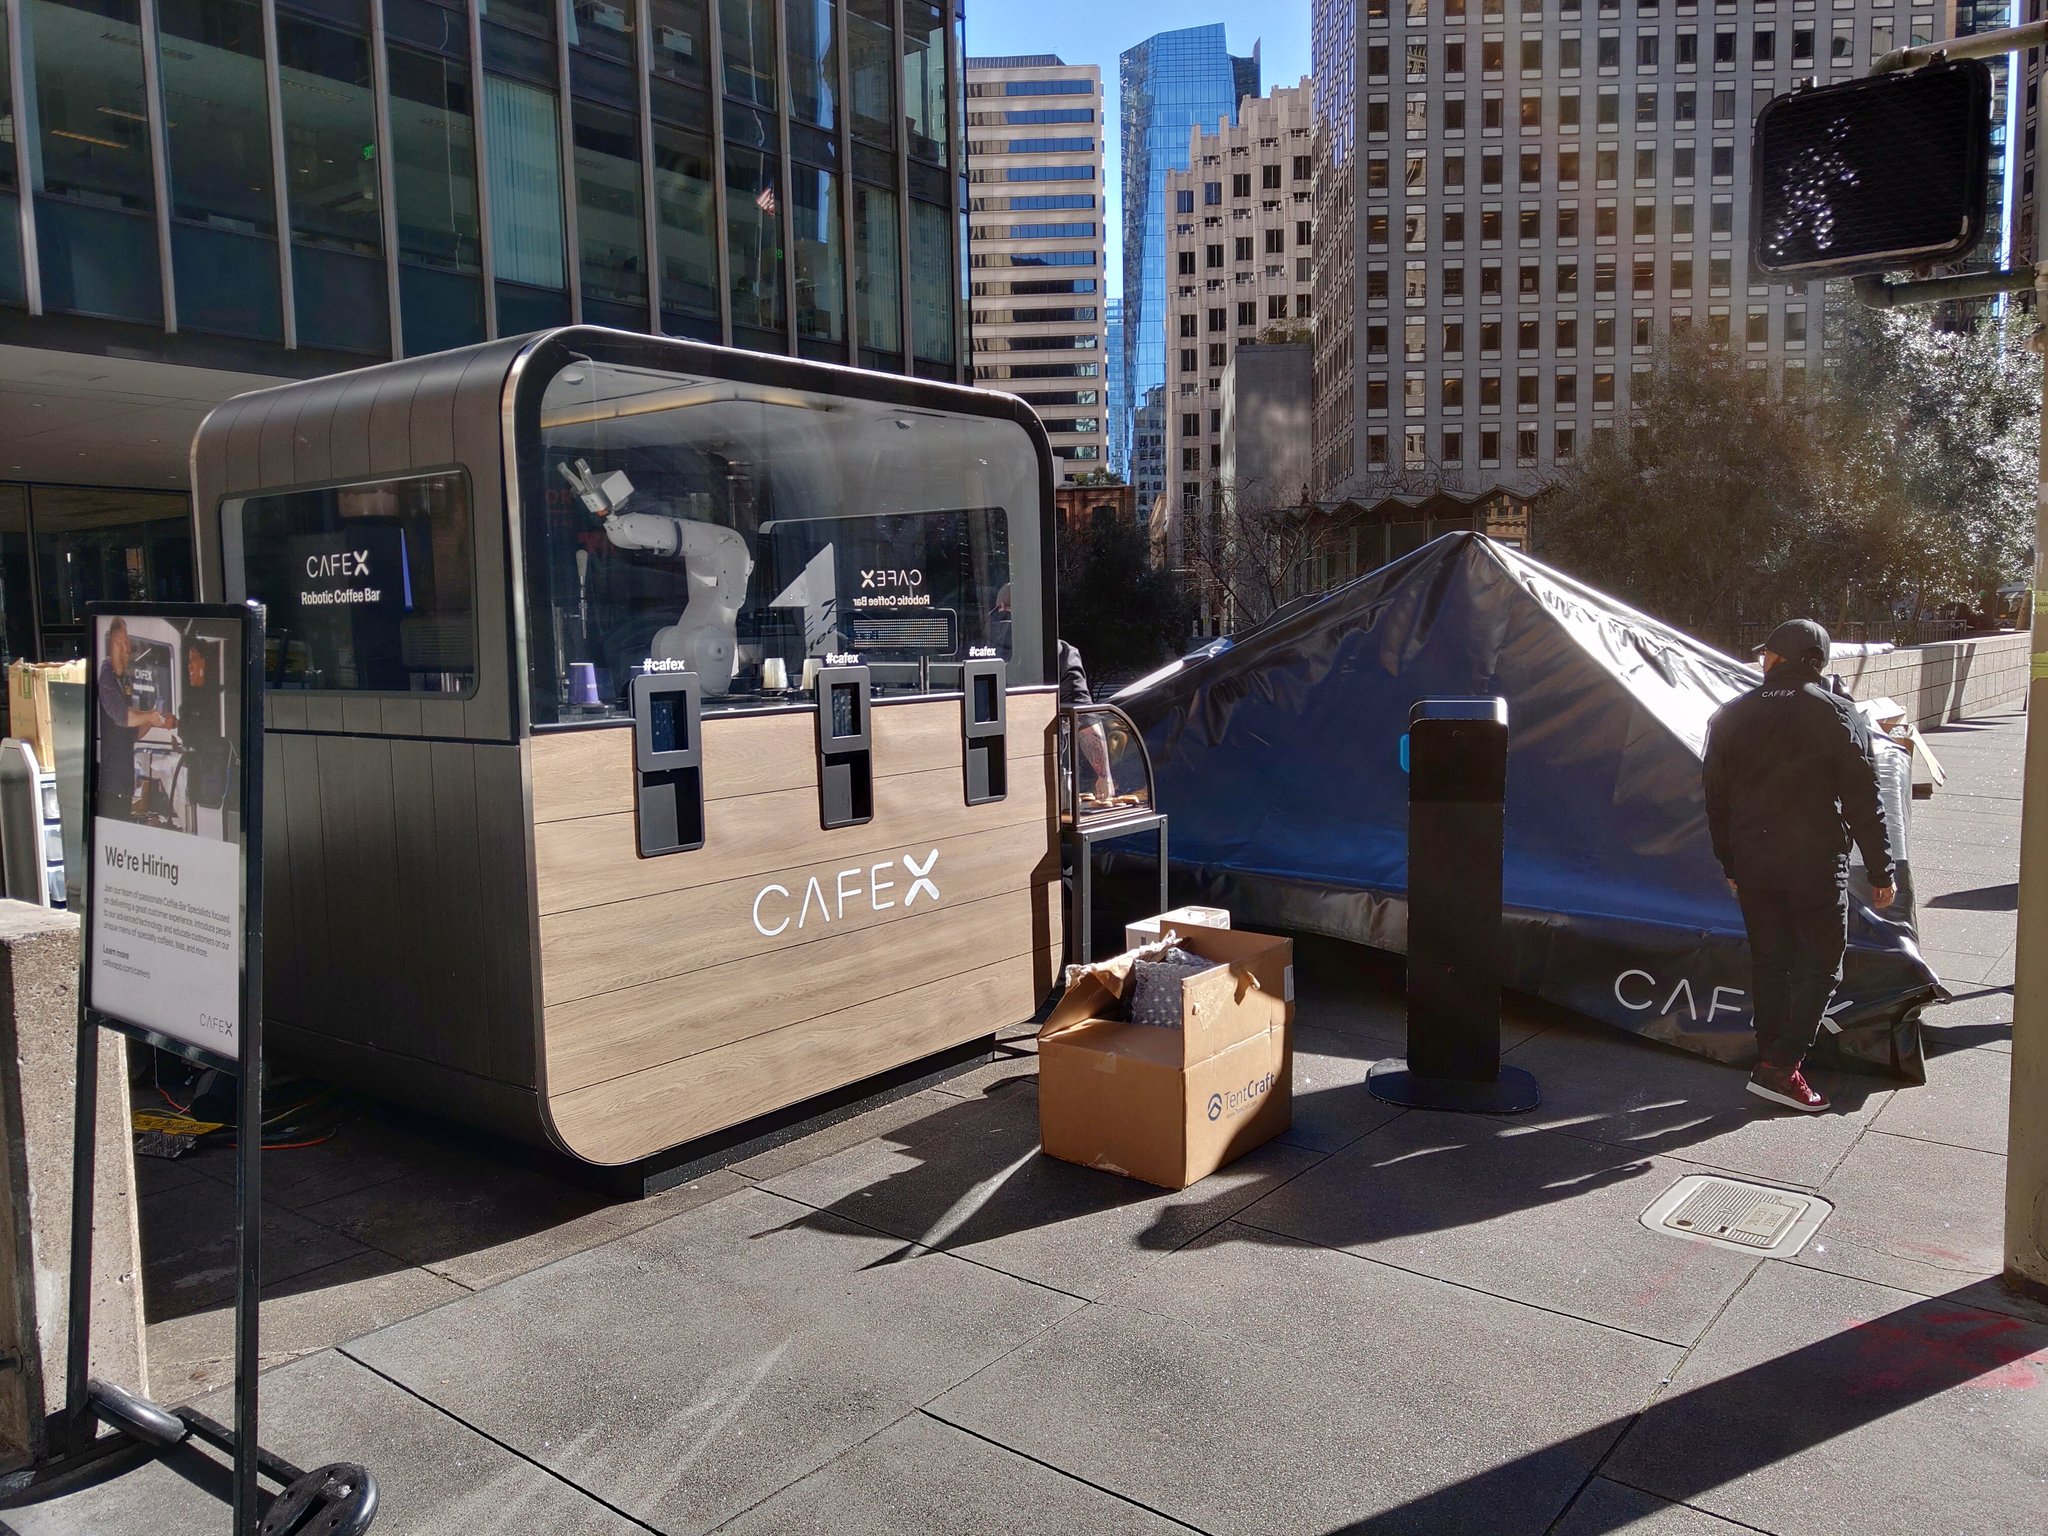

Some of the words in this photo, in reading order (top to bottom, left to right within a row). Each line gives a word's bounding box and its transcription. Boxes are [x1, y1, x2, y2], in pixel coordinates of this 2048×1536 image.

[306, 550, 369, 578] CAFEX
[301, 590, 333, 605] Robotic
[334, 589, 364, 604] Coffee
[364, 588, 380, 602] Bar
[826, 651, 859, 664] #cafex
[969, 645, 997, 657] #cafex
[643, 657, 685, 671] #cafex
[105, 845, 139, 871] We're
[142, 853, 179, 886] Hiring
[753, 848, 940, 936] CAFEX
[1224, 1072, 1275, 1111] TentCraft
